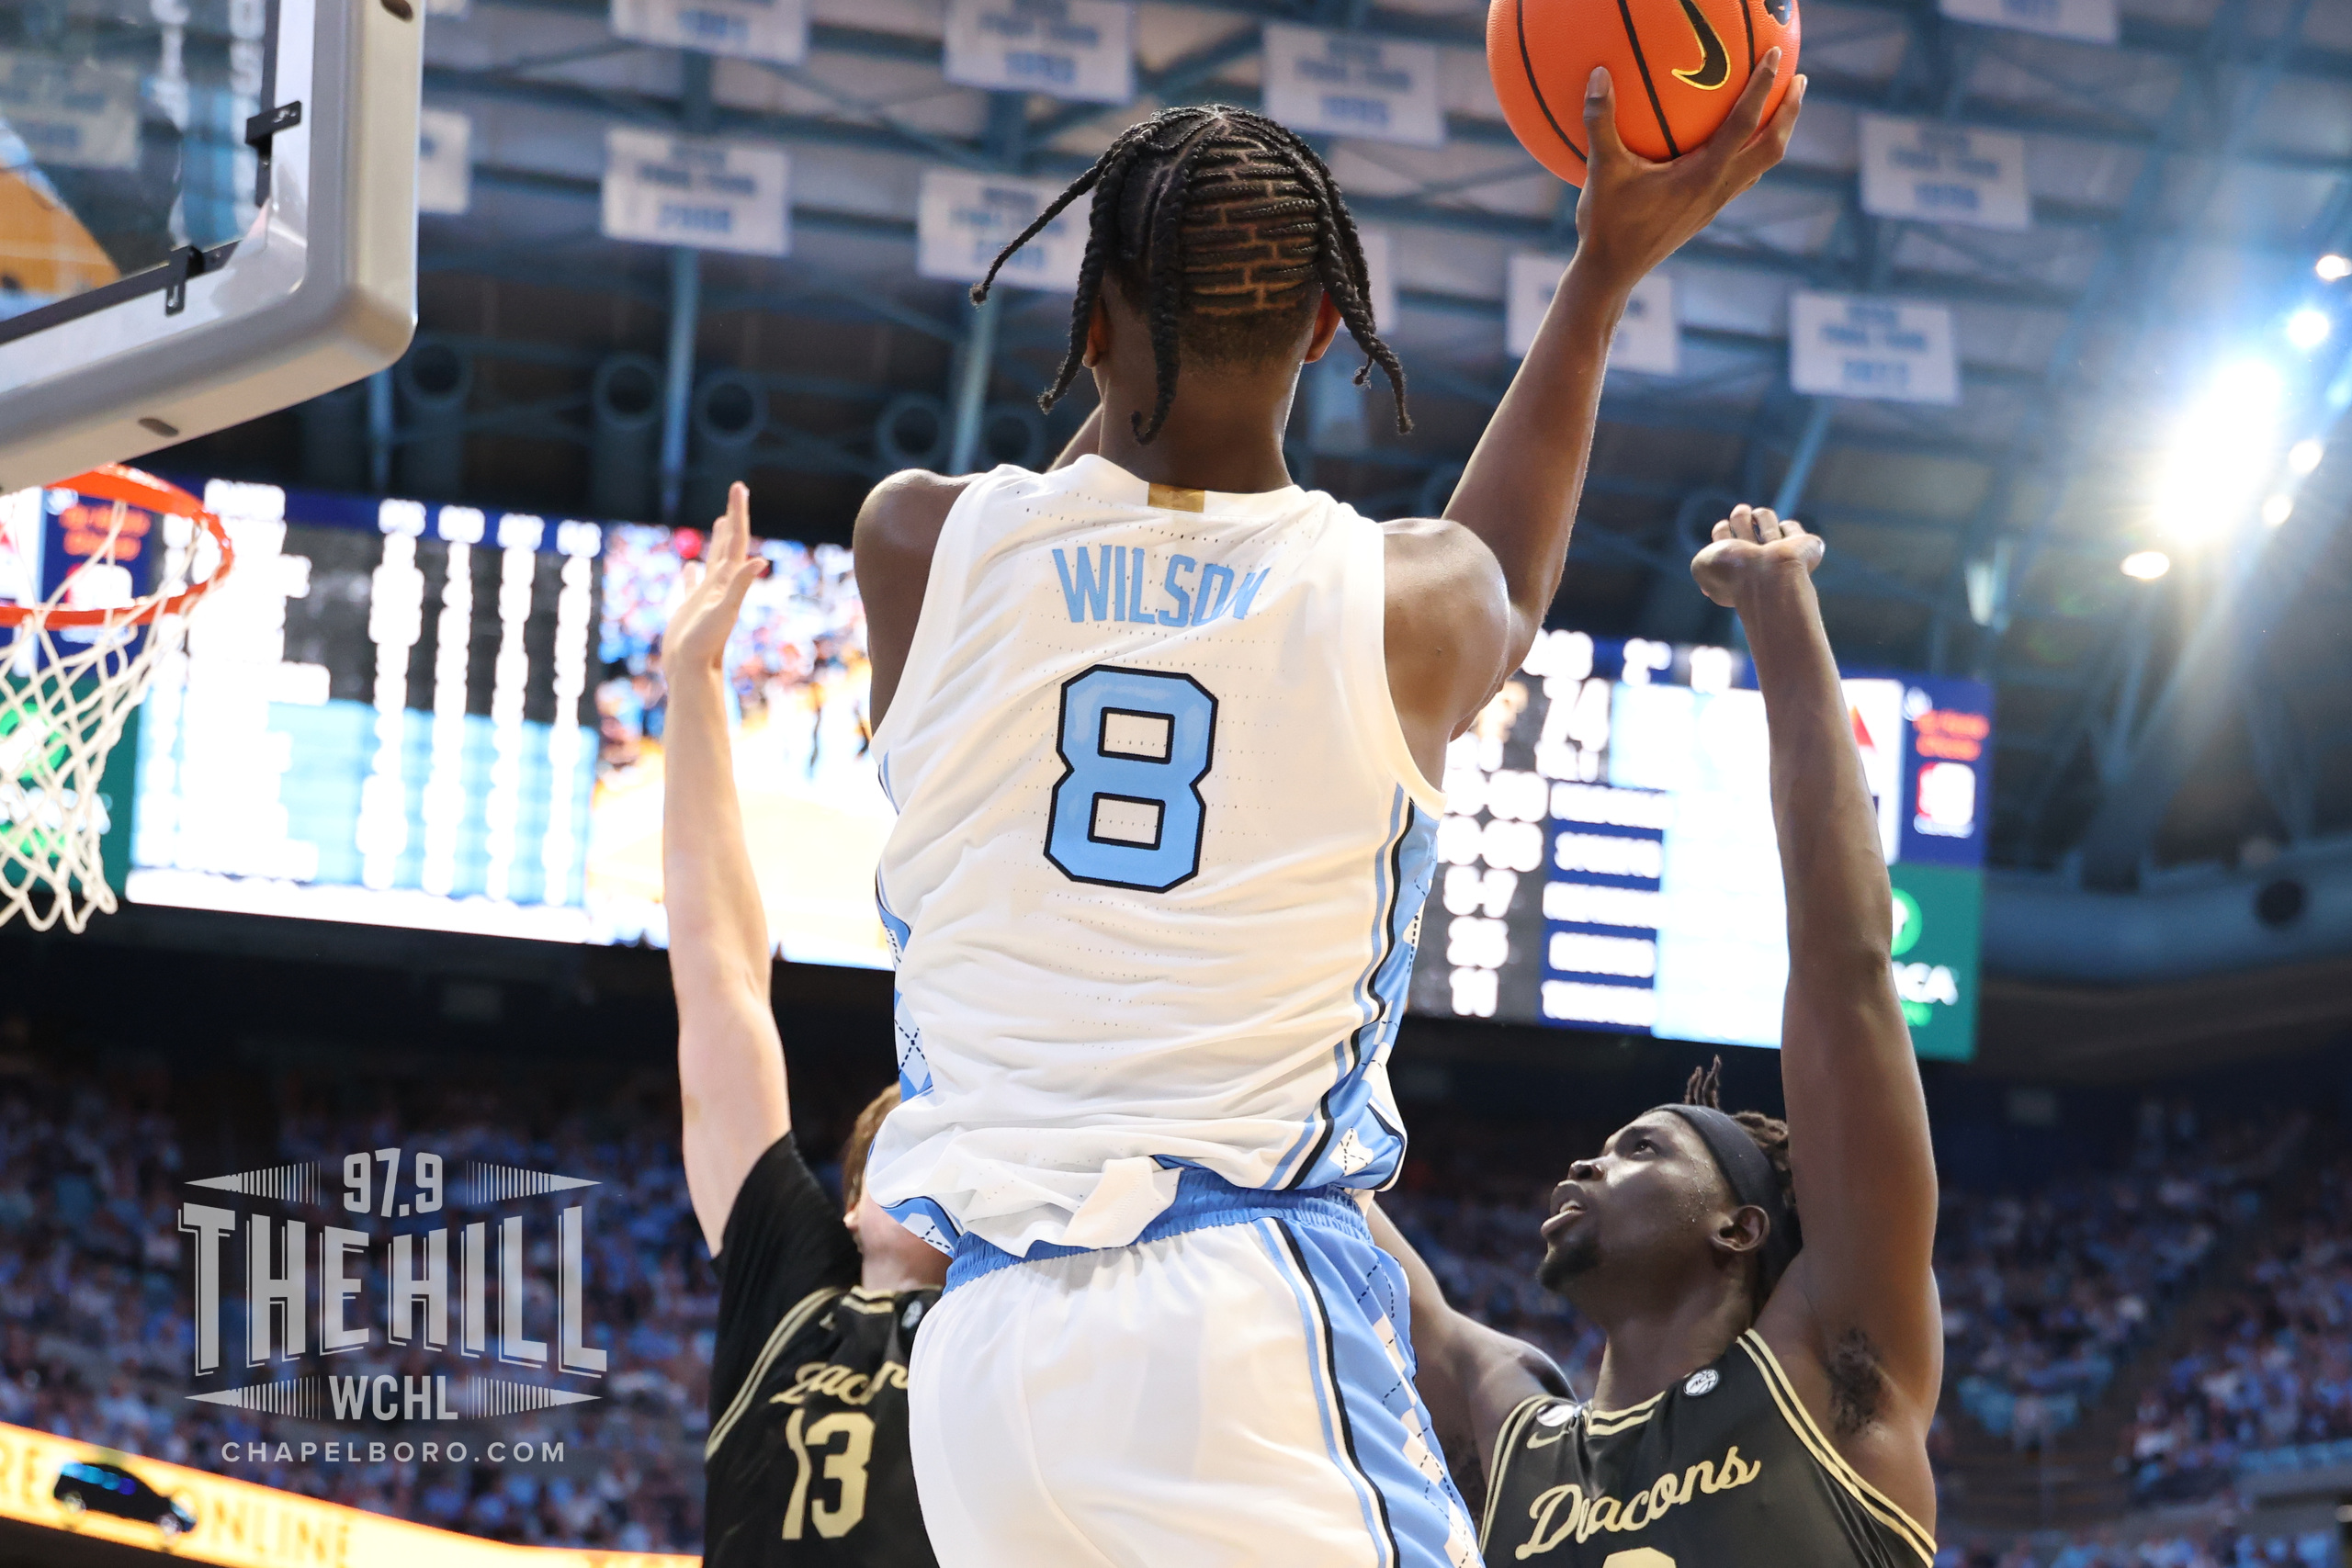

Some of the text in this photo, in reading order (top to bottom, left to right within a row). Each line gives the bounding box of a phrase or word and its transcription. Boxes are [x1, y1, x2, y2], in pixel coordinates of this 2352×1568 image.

[1052, 545, 1271, 628] WILSON
[1044, 663, 1219, 895] 8
[781, 1407, 876, 1540] 13
